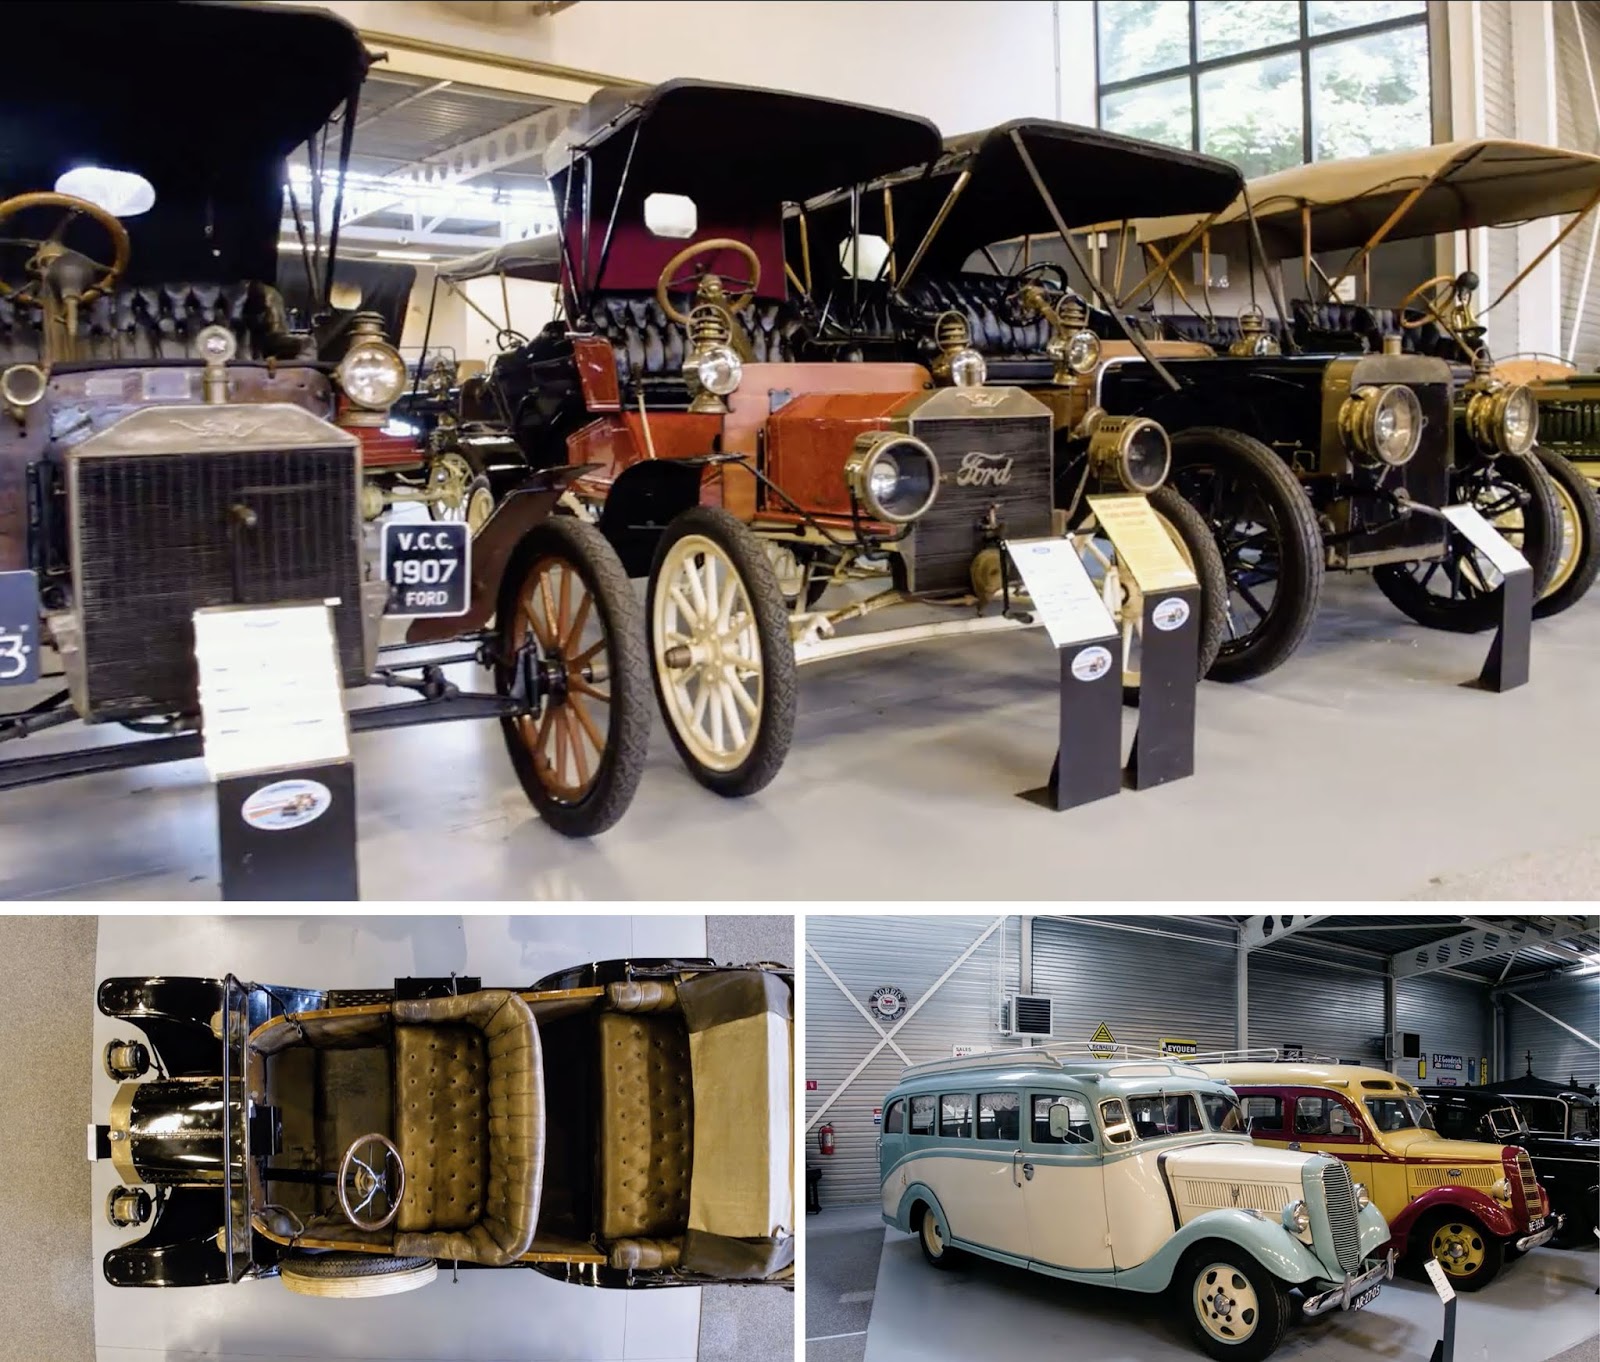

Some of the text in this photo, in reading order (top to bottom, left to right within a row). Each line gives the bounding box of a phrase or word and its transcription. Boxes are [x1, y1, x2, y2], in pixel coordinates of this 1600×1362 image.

[957, 452, 1014, 486] Ford
[397, 532, 454, 551] V.C.C.
[393, 558, 458, 584] 1907
[405, 591, 449, 607] FORD
[873, 987, 903, 999] MORRIS
[1168, 1045, 1196, 1053] EYQUEM
